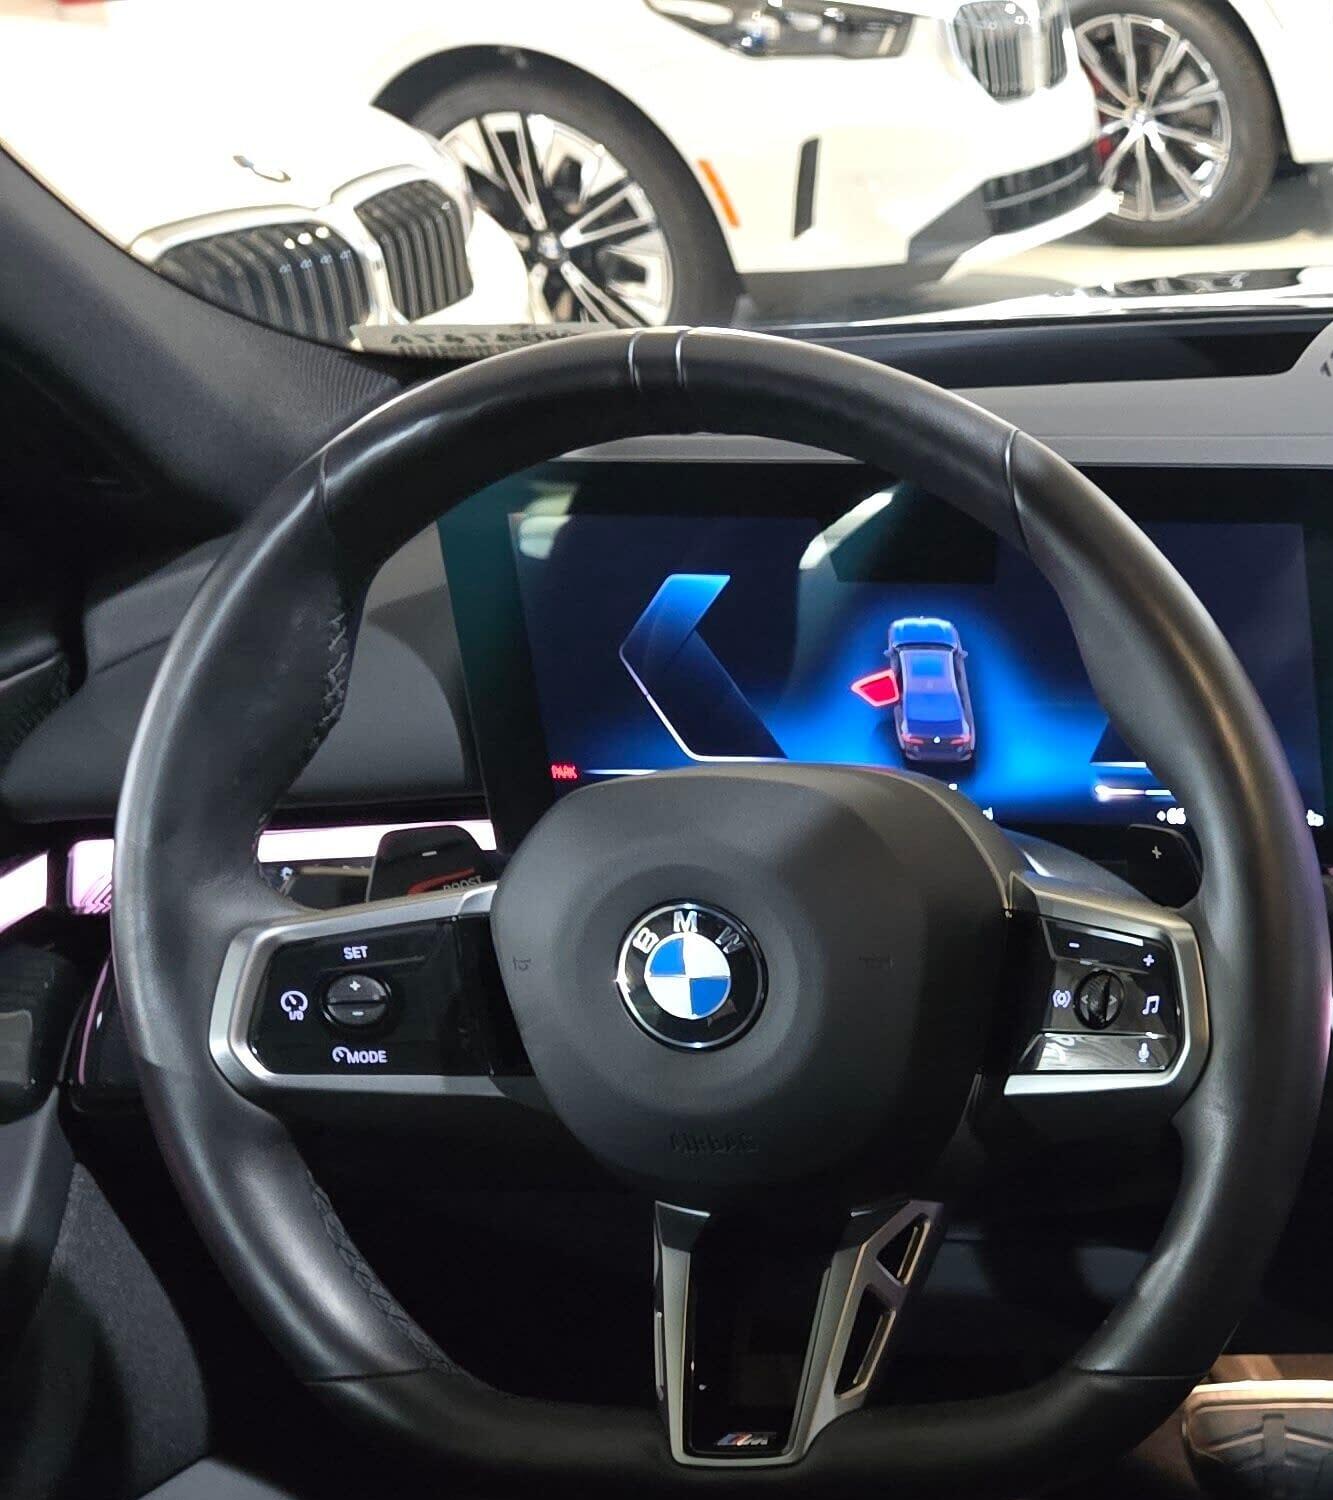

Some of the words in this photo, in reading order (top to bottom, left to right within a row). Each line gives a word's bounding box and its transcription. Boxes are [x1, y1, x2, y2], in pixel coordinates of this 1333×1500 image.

[551, 765, 578, 778] PARK
[632, 910, 746, 954] BMW
[343, 945, 368, 960] SET
[347, 1050, 387, 1063] MODE
